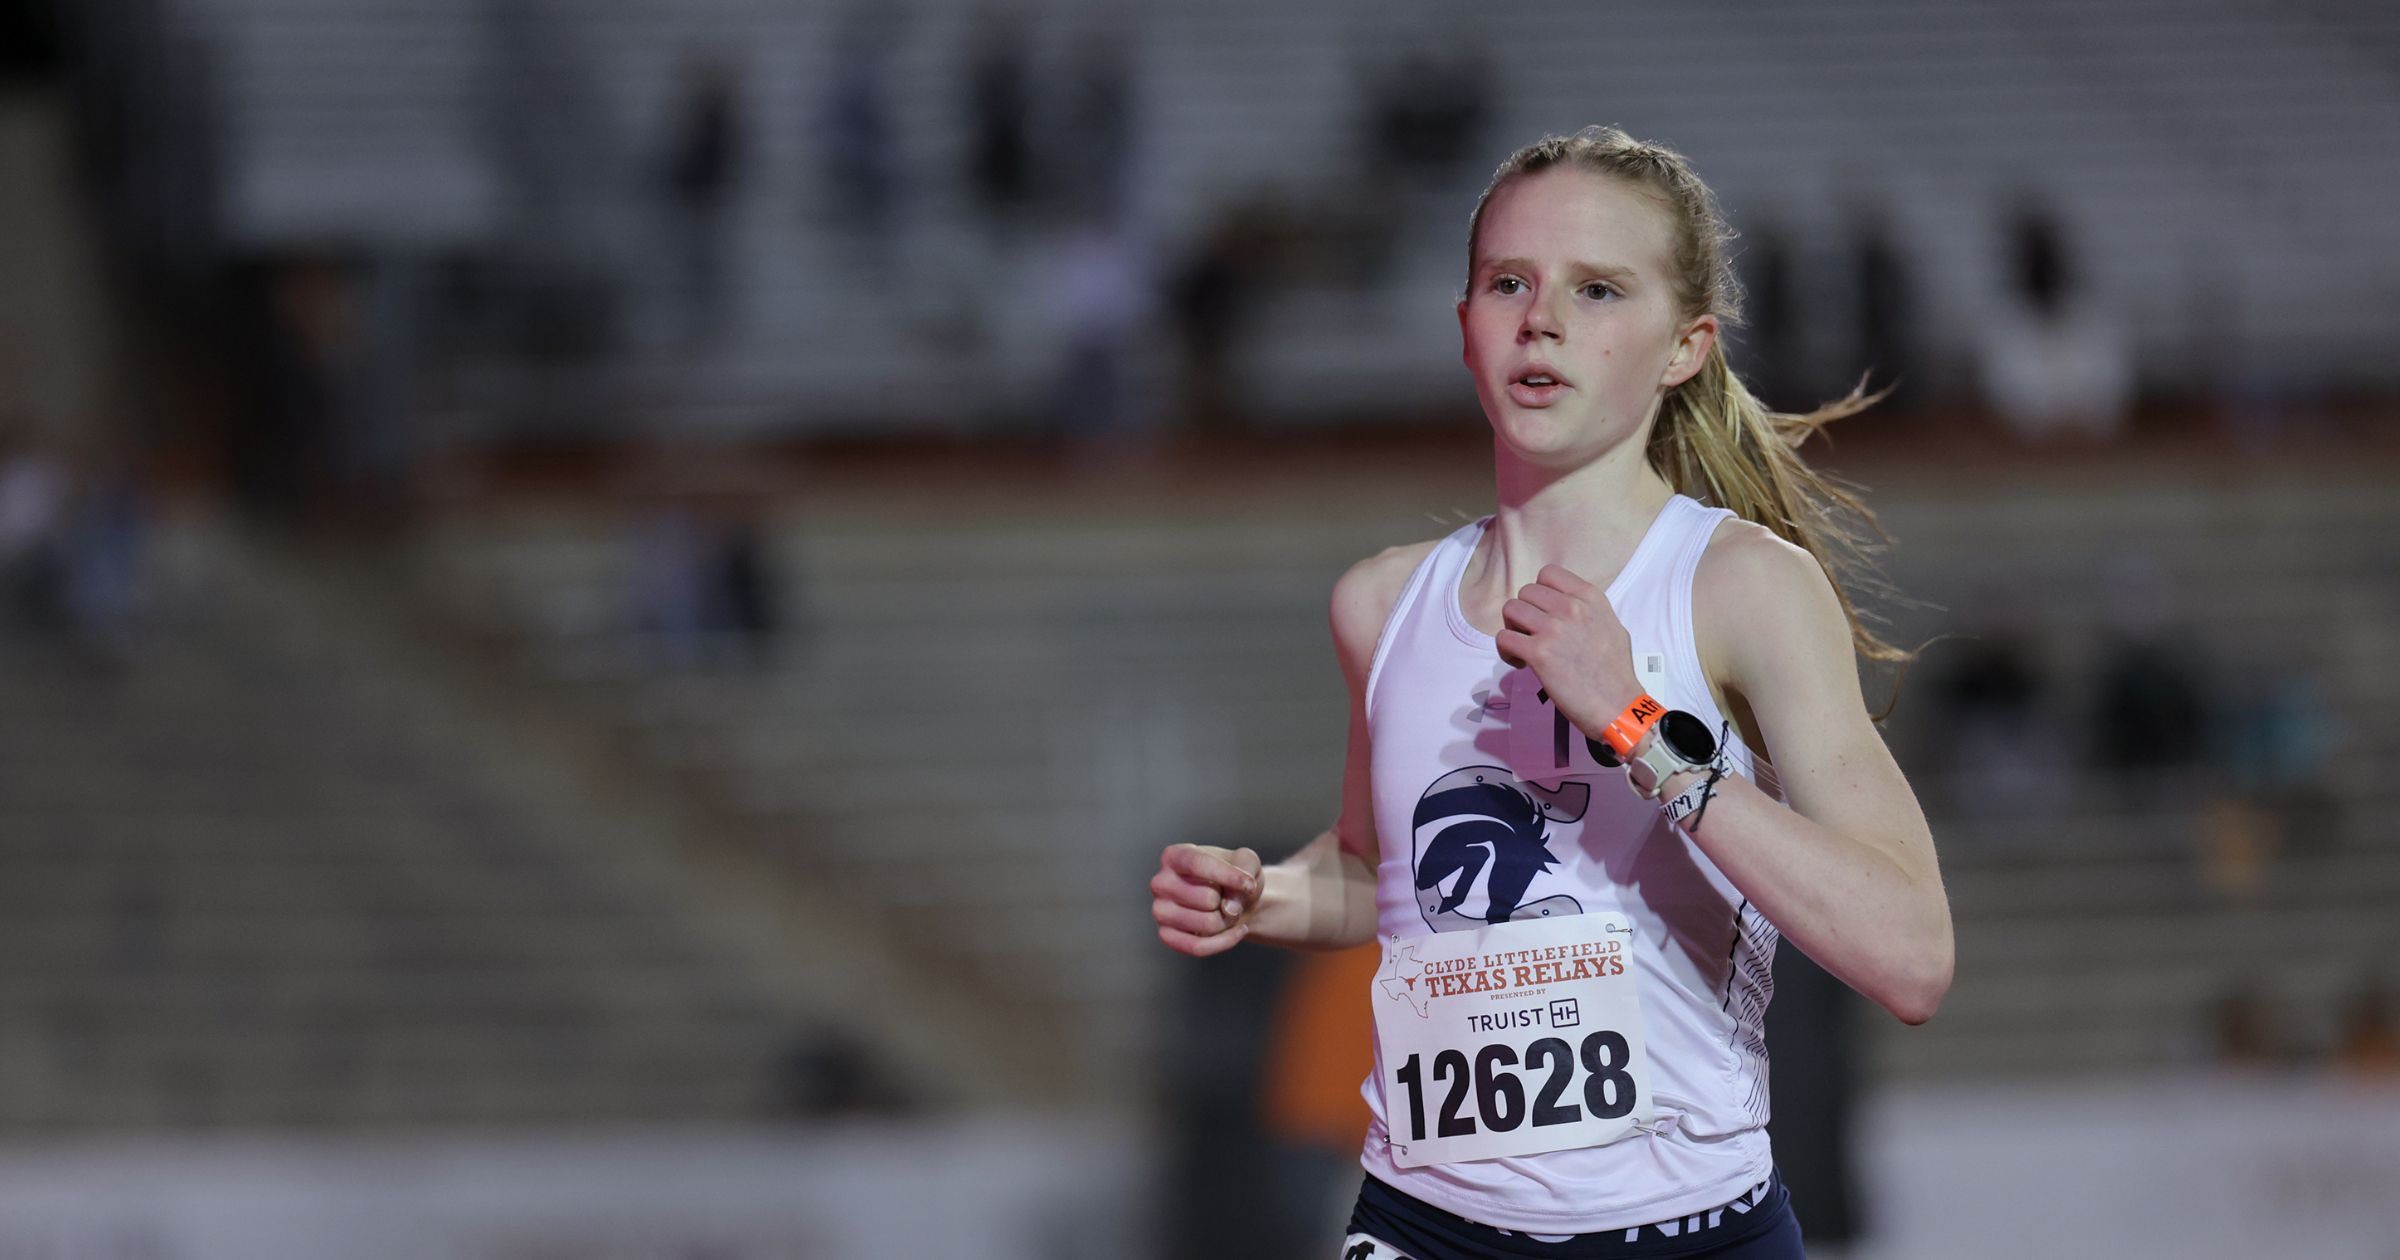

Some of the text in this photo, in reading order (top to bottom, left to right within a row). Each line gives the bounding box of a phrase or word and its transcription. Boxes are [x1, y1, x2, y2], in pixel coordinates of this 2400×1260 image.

[1424, 940, 1622, 975] CLYDE LITTLEFIELD
[1425, 955, 1625, 998] TEXAS RELAYS
[1490, 990, 1535, 1001] PRESENTED
[1467, 1008, 1544, 1033] TRUIST
[1396, 1030, 1637, 1141] 12628
